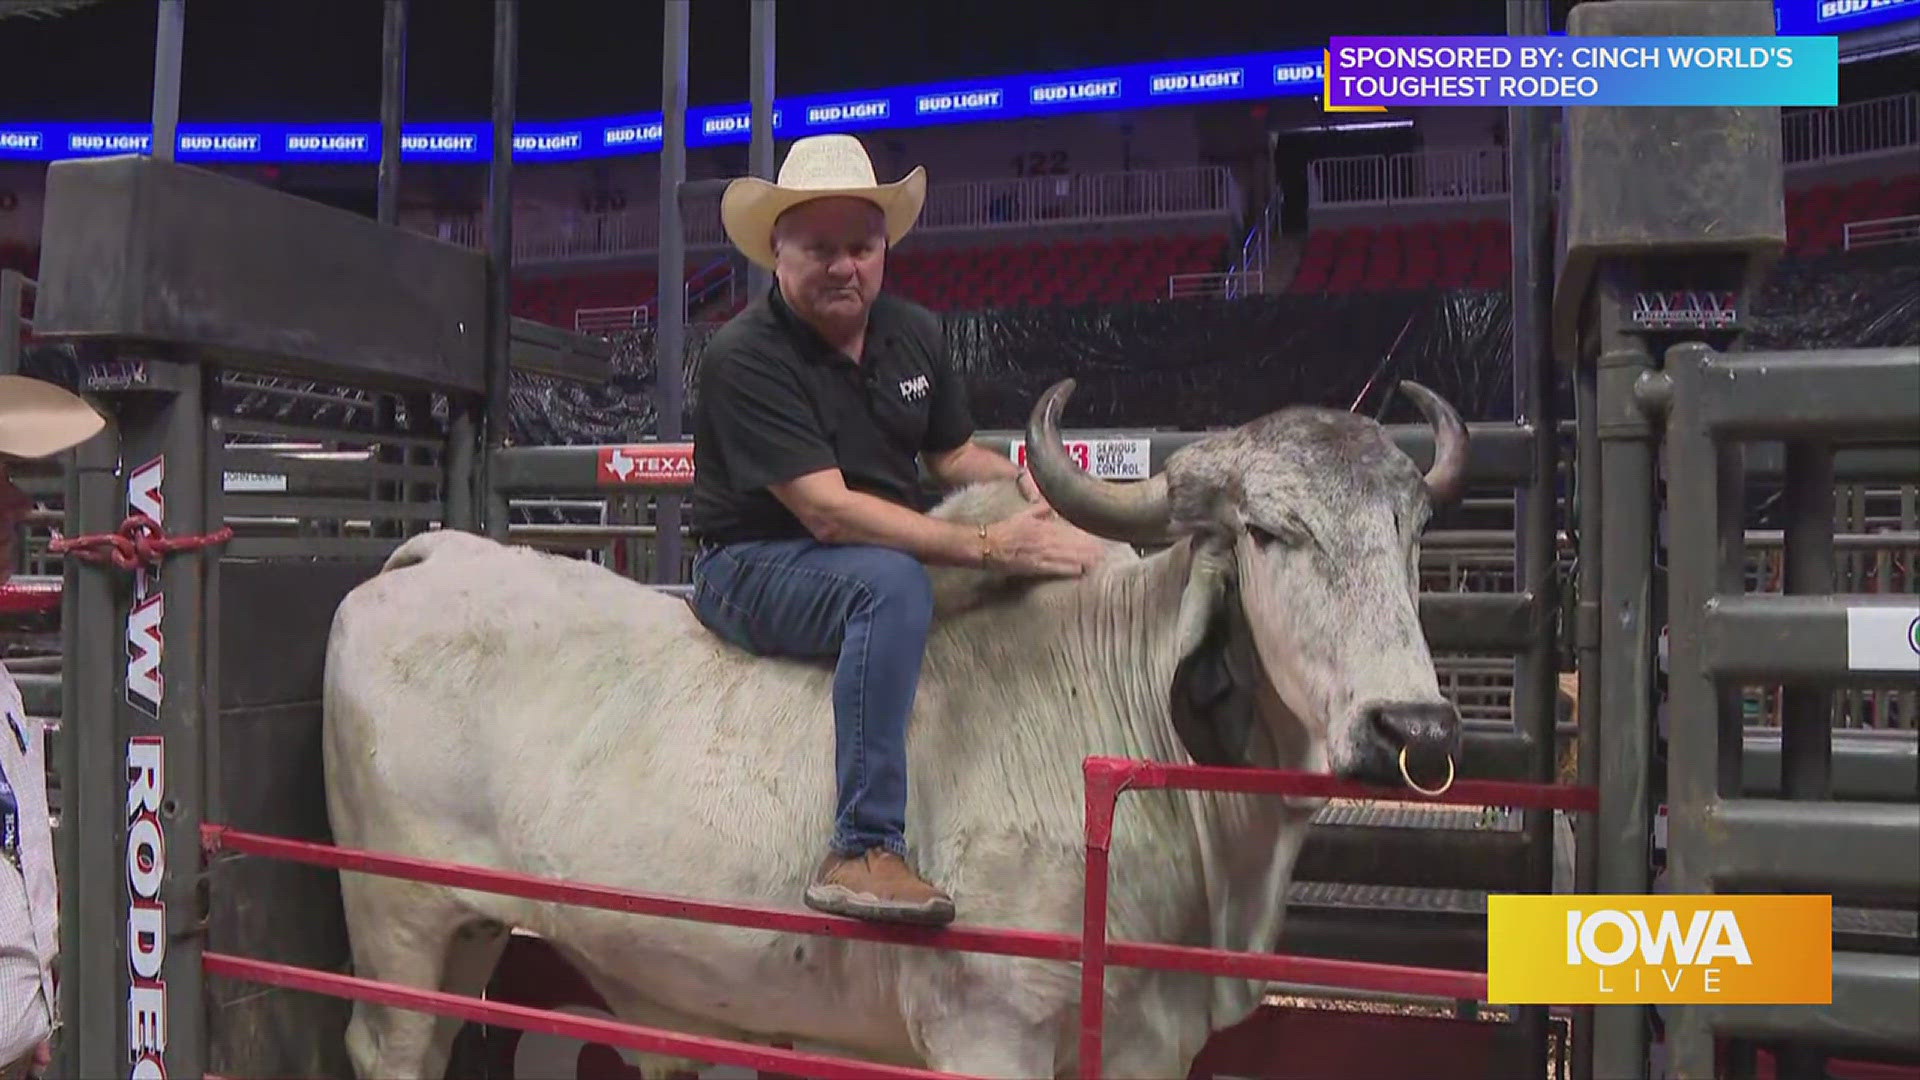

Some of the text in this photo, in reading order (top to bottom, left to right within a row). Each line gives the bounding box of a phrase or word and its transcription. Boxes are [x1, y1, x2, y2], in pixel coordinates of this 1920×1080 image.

[1277, 64, 1314, 82] BUD
[1153, 71, 1241, 91] BUD LIGHT
[1033, 81, 1118, 101] BUD LIGHT
[918, 91, 999, 111] BUD LIGHT
[809, 102, 887, 122] BUD LIGHT
[705, 117, 735, 133] BUD
[71, 136, 150, 149] BUD LIGHT
[181, 136, 258, 149] BUD LIGHT
[289, 136, 366, 149] BUD LIGHT
[430, 136, 474, 149] LIGHT
[538, 134, 578, 149] LIGHT
[606, 127, 633, 143] BUD
[899, 374, 930, 398] IOWA
[1096, 442, 1137, 453] SERIOUS
[634, 457, 695, 471] TEXA
[1095, 453, 1125, 464] WEED
[1096, 463, 1140, 475] CONTROL
